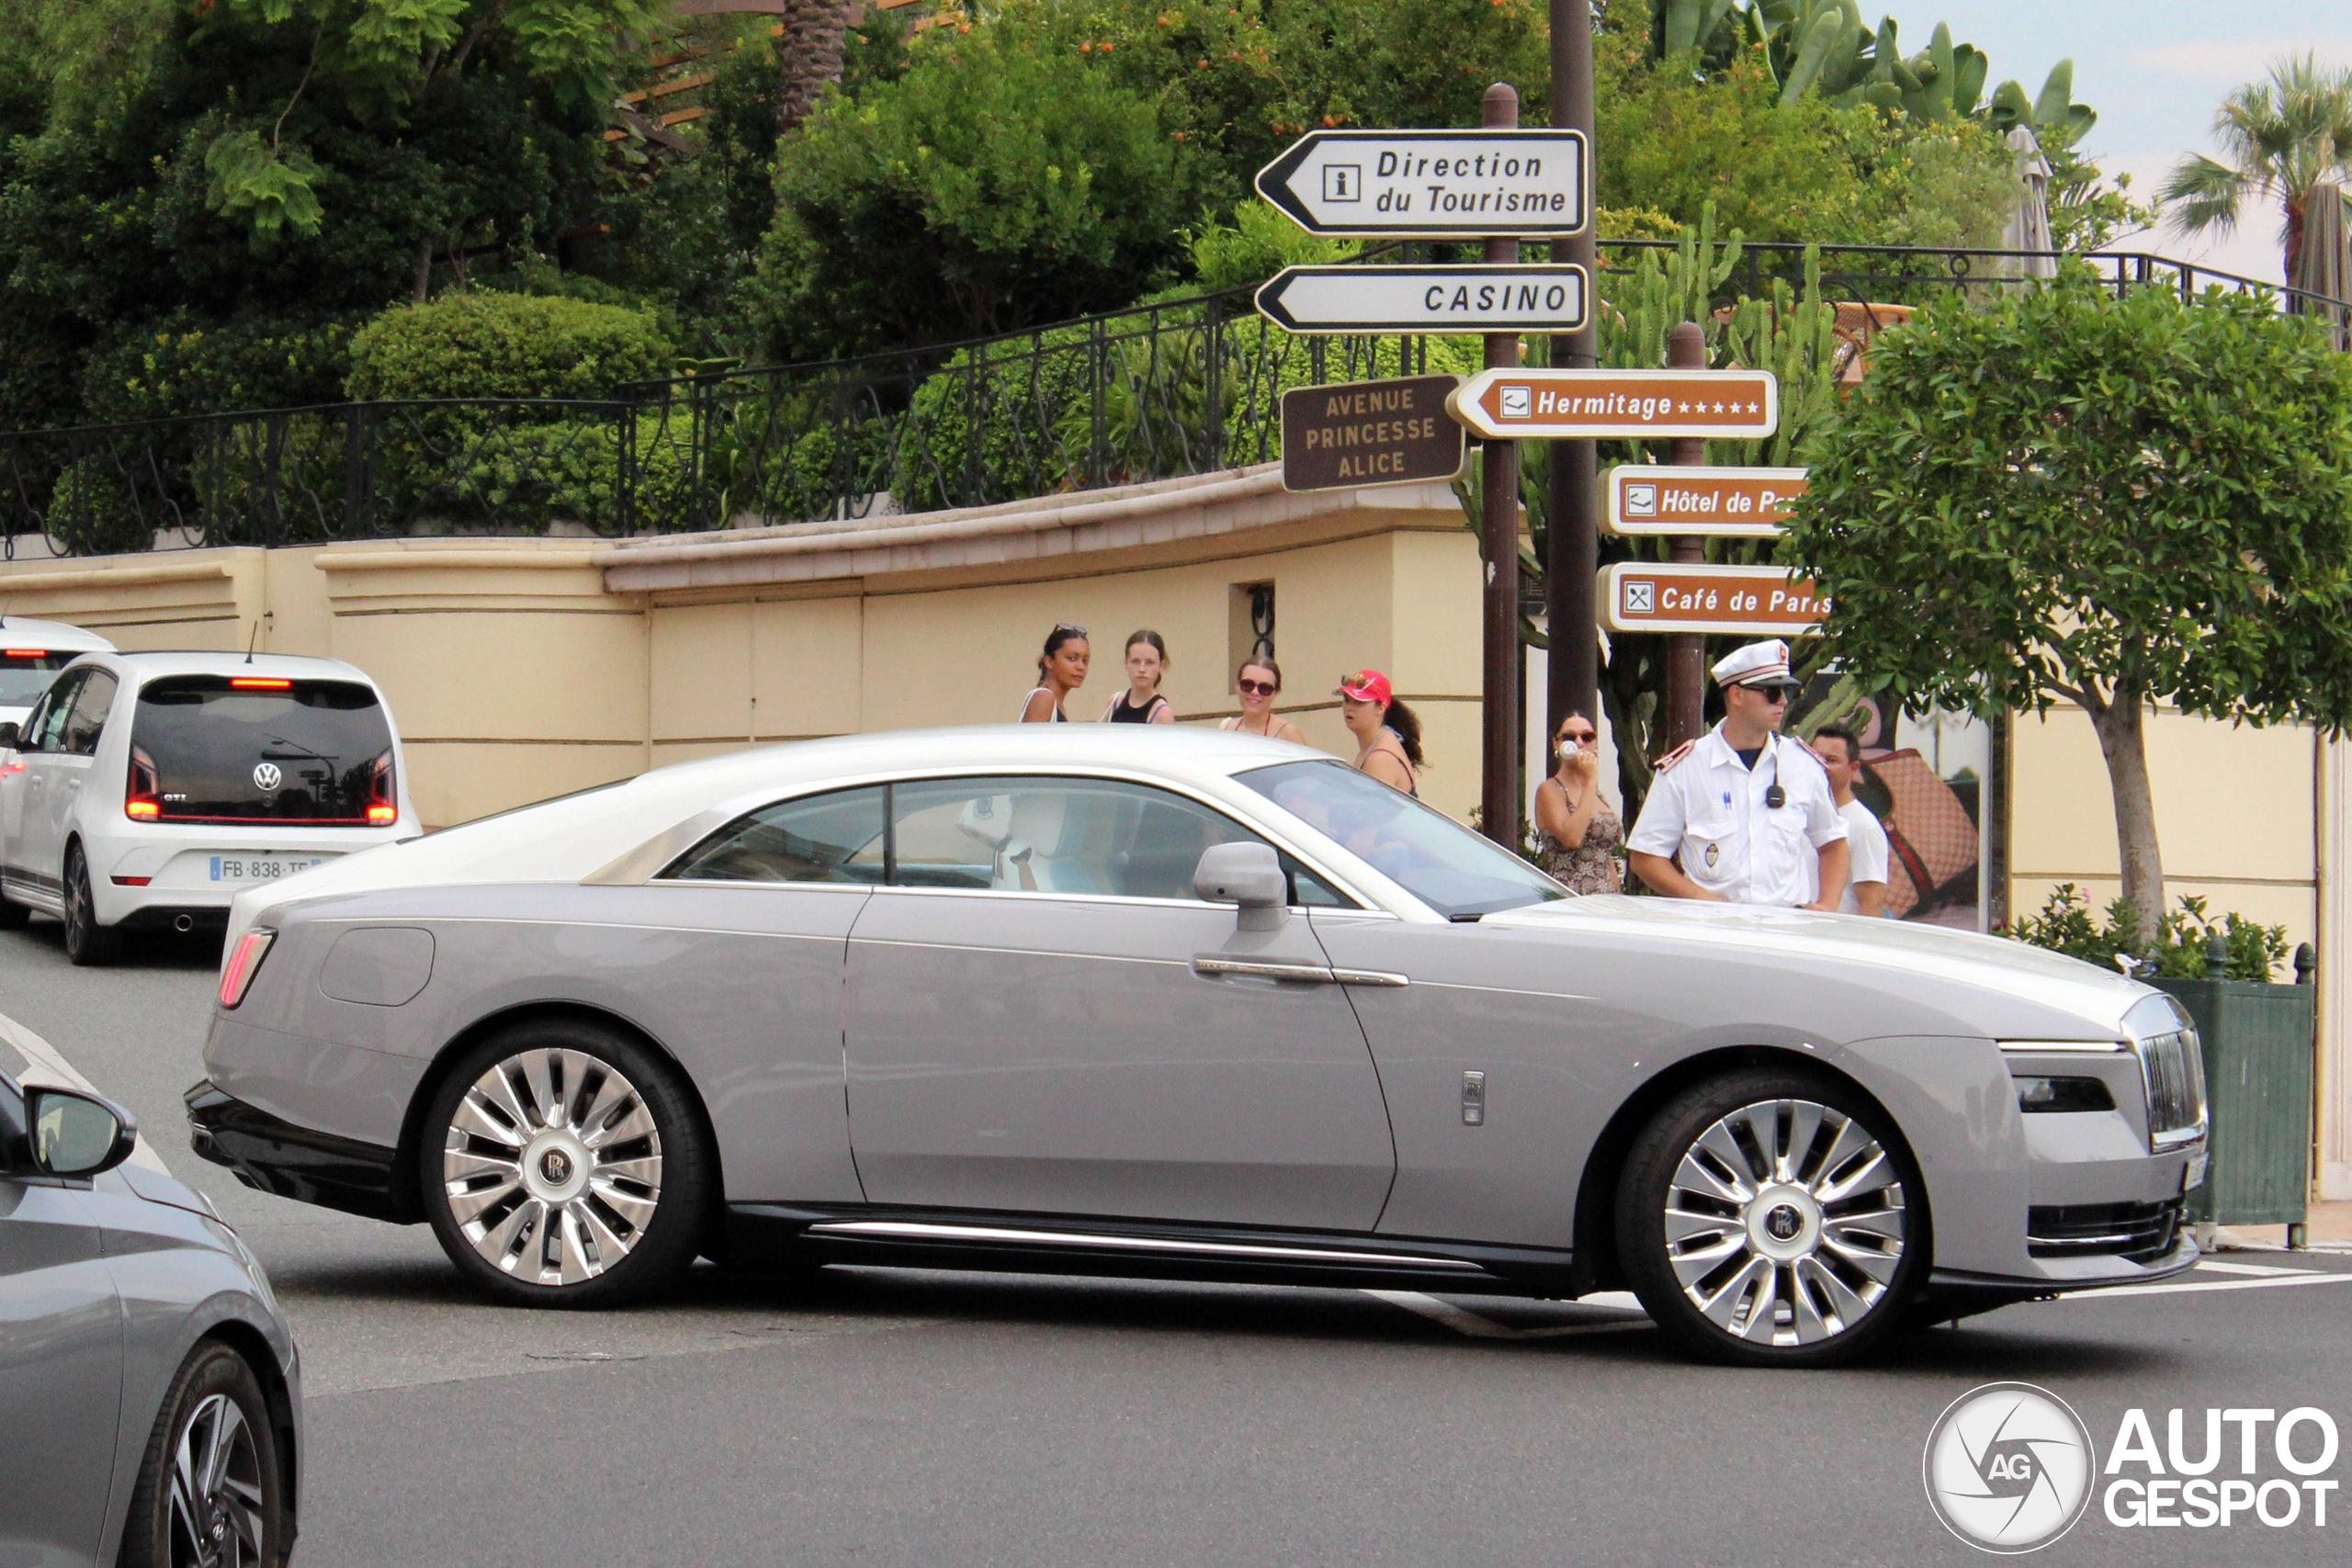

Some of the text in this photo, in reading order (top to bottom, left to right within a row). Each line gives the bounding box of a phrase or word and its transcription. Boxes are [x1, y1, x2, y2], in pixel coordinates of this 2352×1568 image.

[1376, 151, 1542, 178] Direction
[1376, 186, 1566, 212] du Tourisme
[1424, 285, 1566, 311] CASINO
[1326, 389, 1414, 417] AVENUE
[1537, 390, 1672, 420] Hermitage
[1306, 417, 1435, 450] PRINCESSE
[1339, 451, 1405, 478] ALICE
[1661, 489, 1719, 513] Hôtel
[1726, 491, 1752, 513] de
[1661, 588, 1718, 611] Café
[1729, 591, 1758, 612] de
[164, 794, 187, 802] GTI
